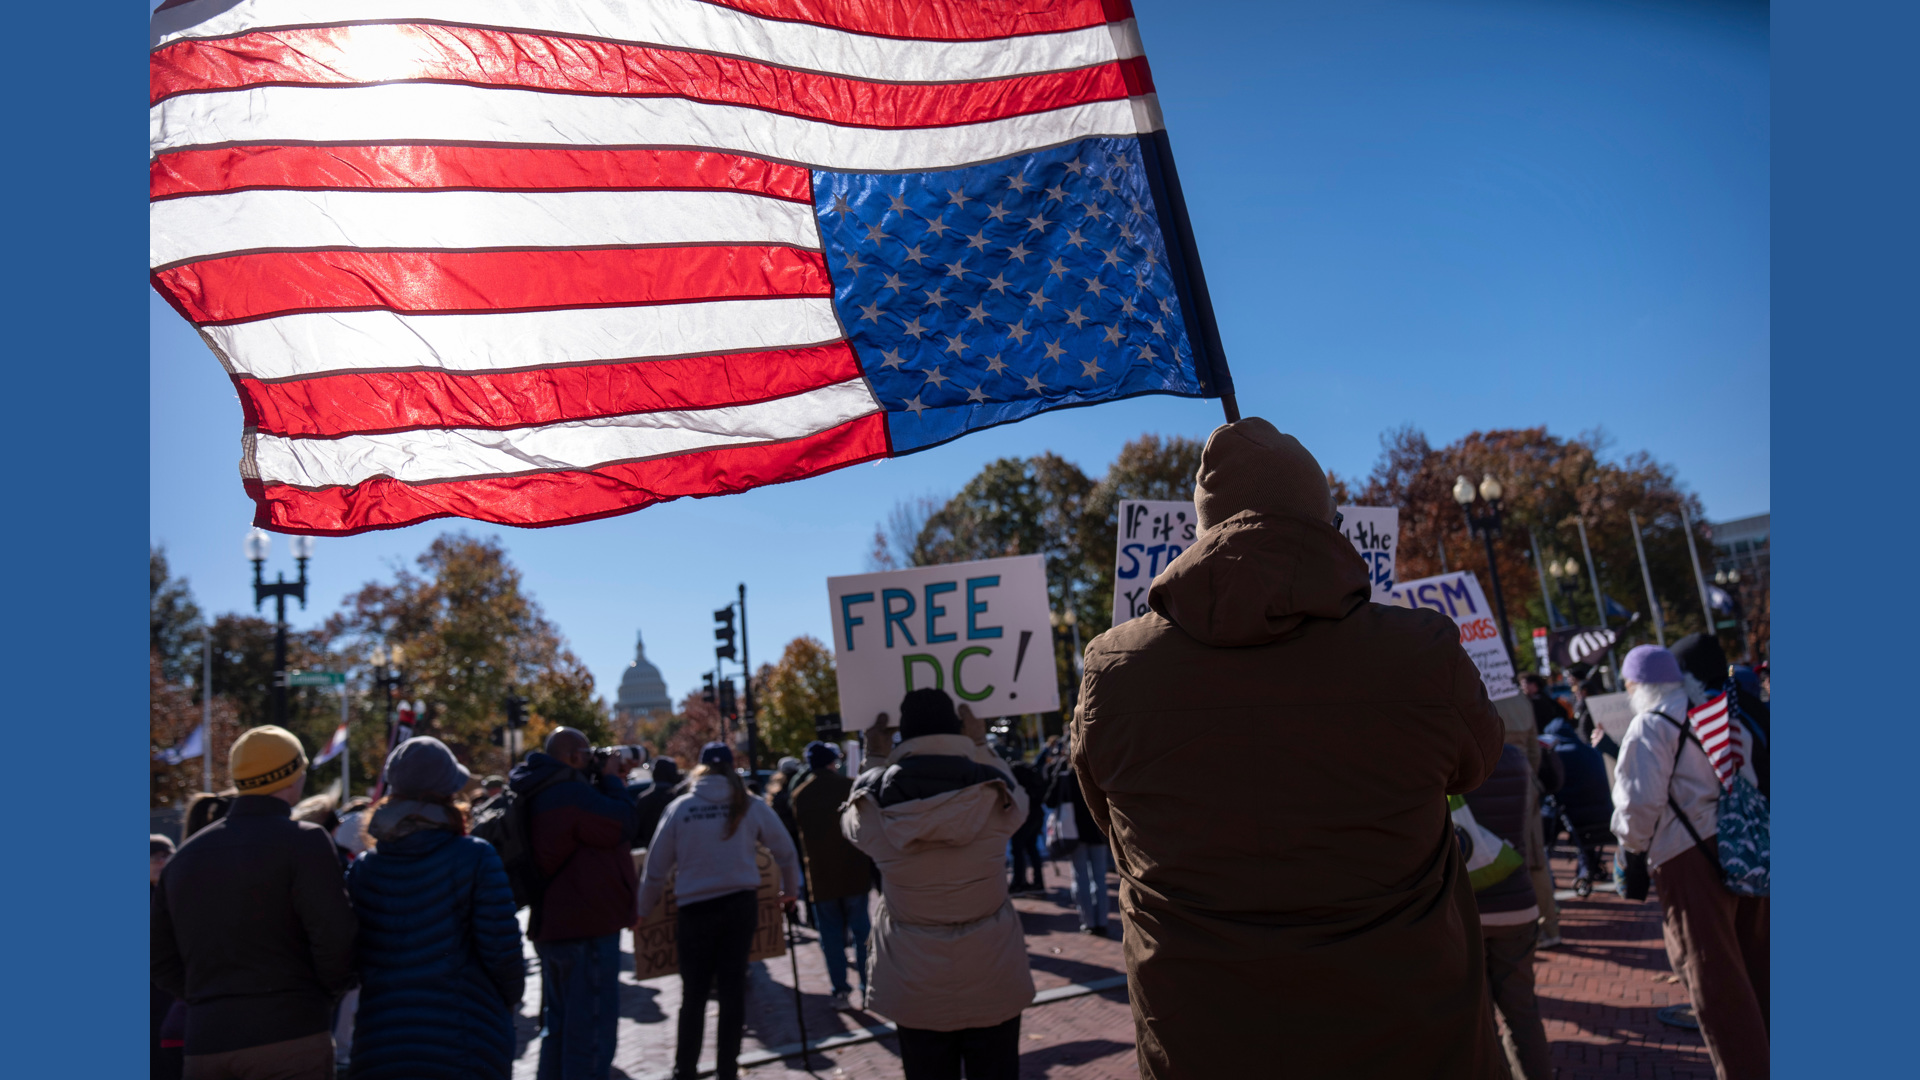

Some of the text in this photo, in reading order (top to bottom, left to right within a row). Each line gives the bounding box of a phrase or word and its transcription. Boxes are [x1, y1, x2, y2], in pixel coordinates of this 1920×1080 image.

[1126, 503, 1196, 541] If it's
[1353, 520, 1391, 550] the
[841, 574, 1004, 652] FREE
[1124, 587, 1152, 618] Yo
[1392, 576, 1478, 618] ISM
[1460, 617, 1498, 644] OXES
[902, 630, 1034, 702] DC!
